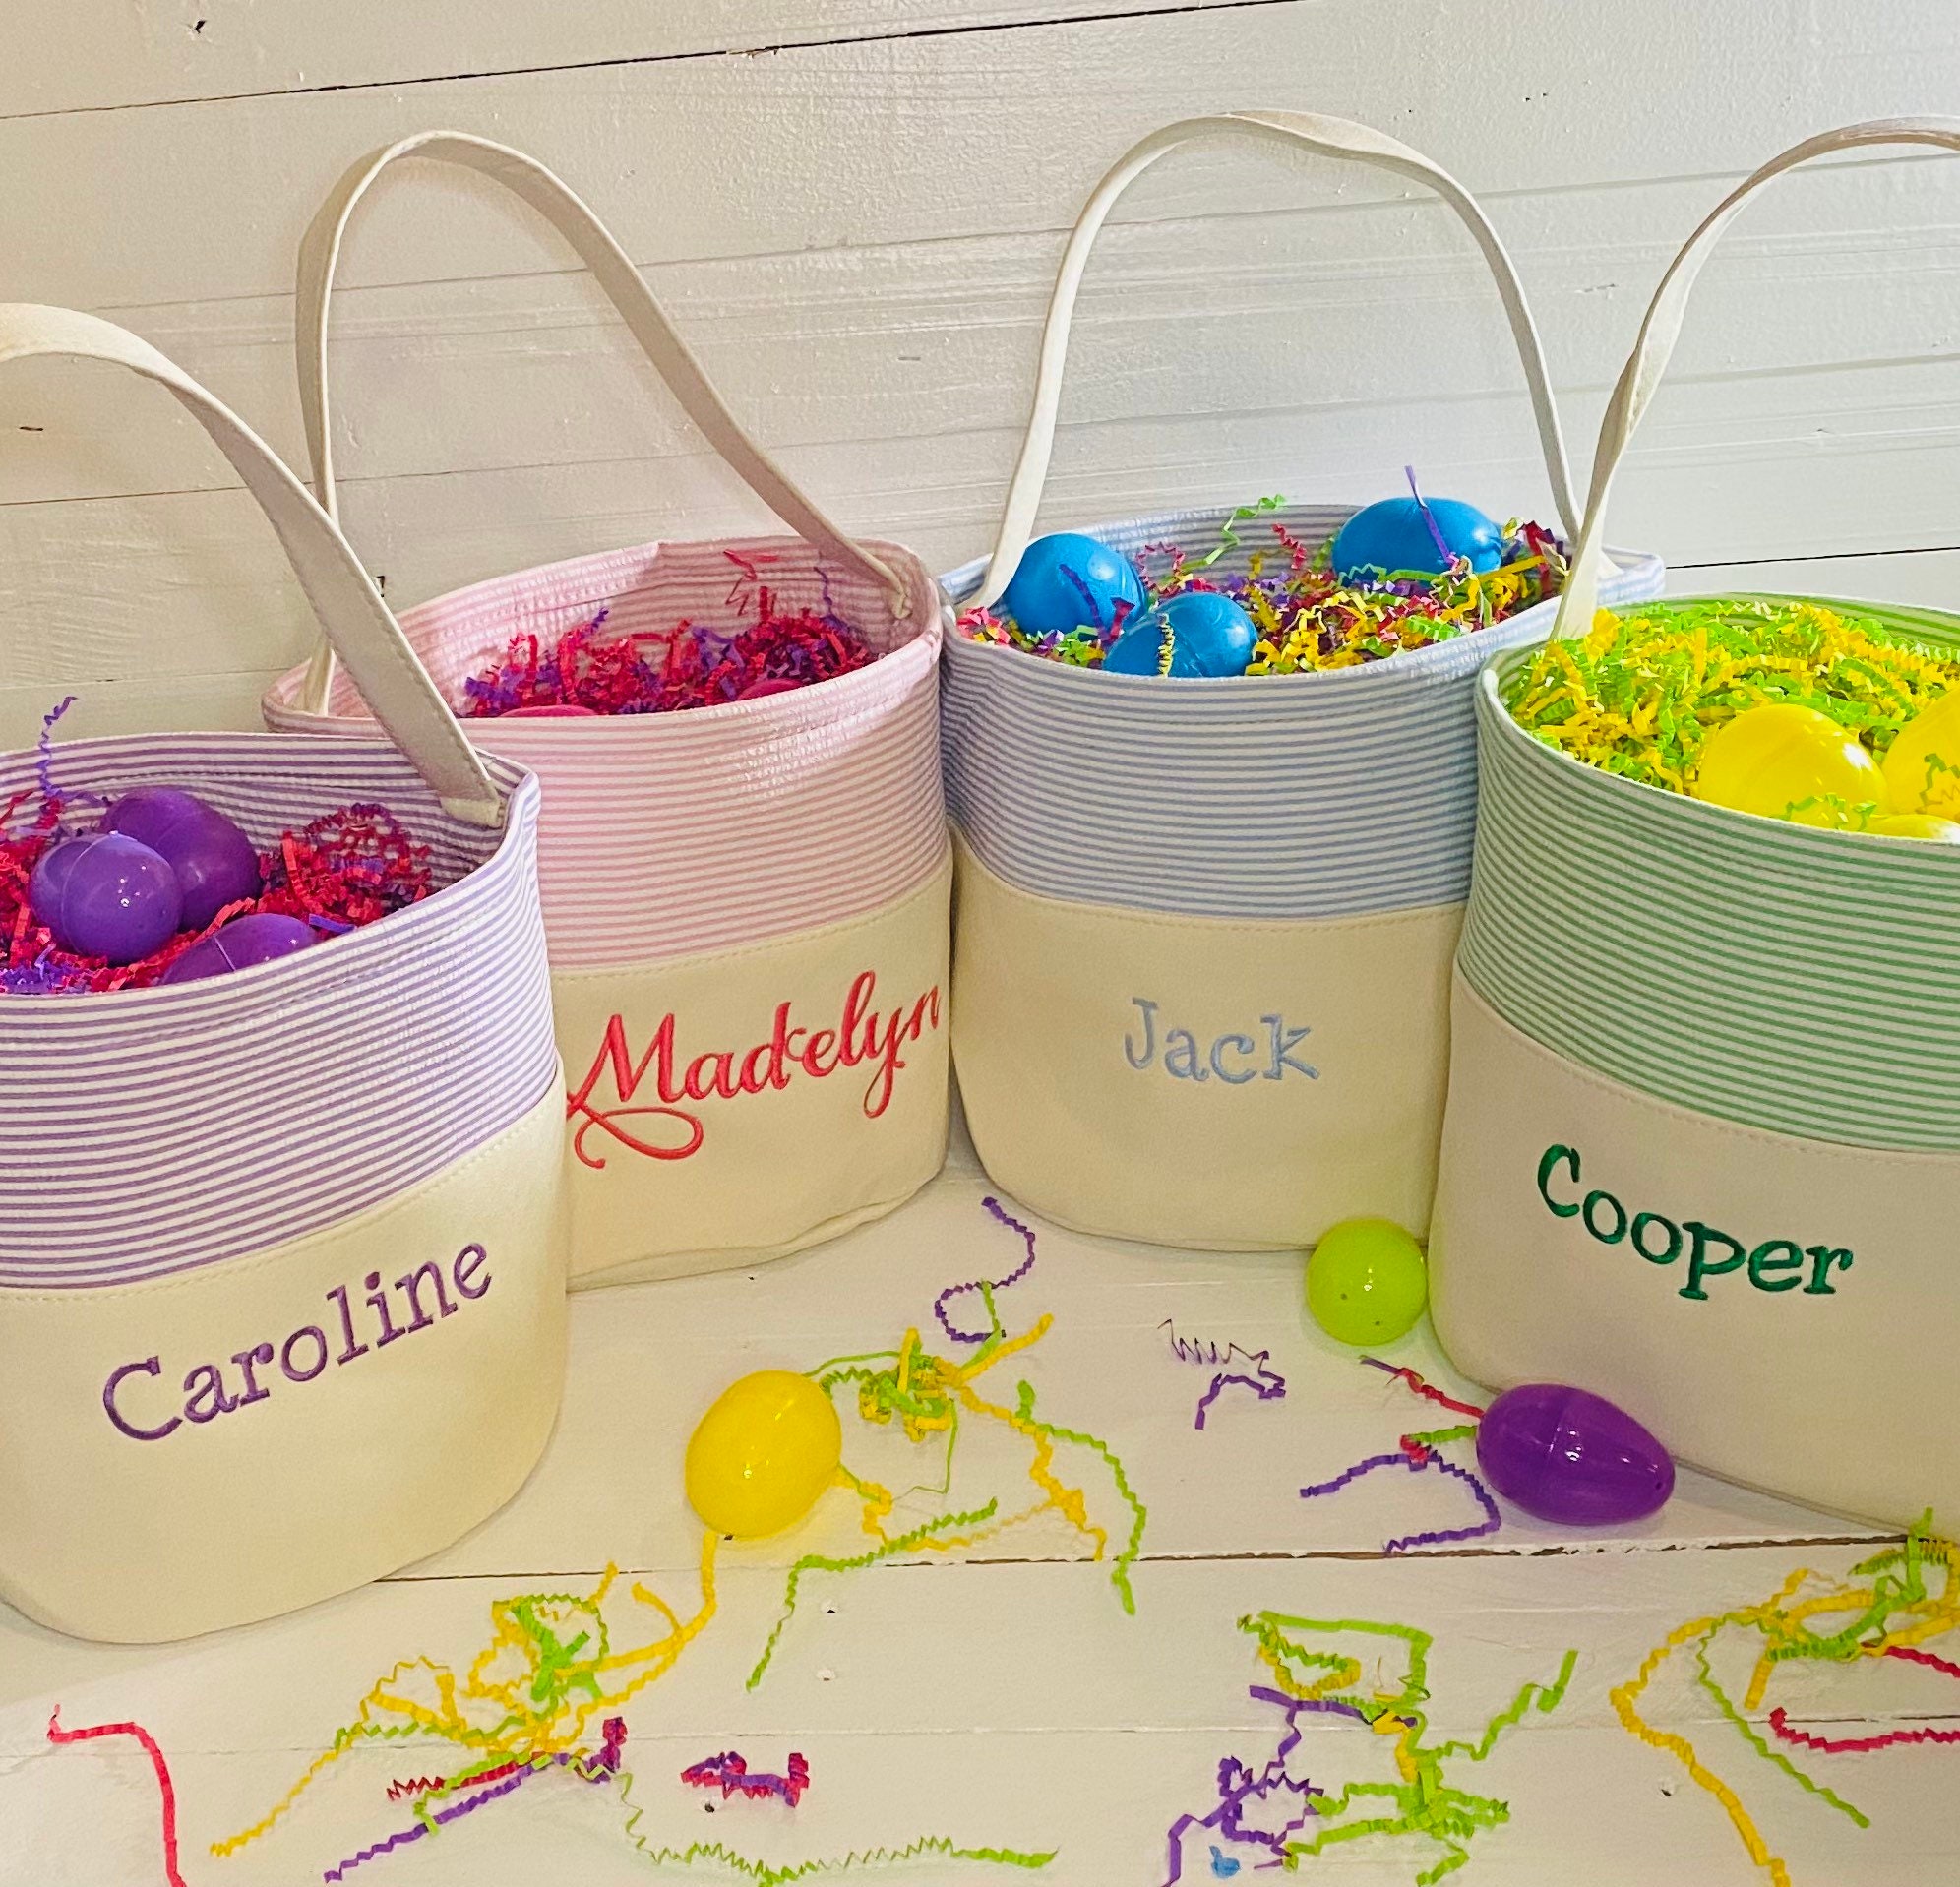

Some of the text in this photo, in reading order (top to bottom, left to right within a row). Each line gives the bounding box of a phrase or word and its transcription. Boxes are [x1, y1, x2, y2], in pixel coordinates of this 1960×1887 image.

[566, 970, 941, 1170] Madelyn
[1124, 997, 1320, 1085] Jack
[1536, 1143, 1855, 1301] Cooper
[101, 1242, 493, 1442] Caroline
